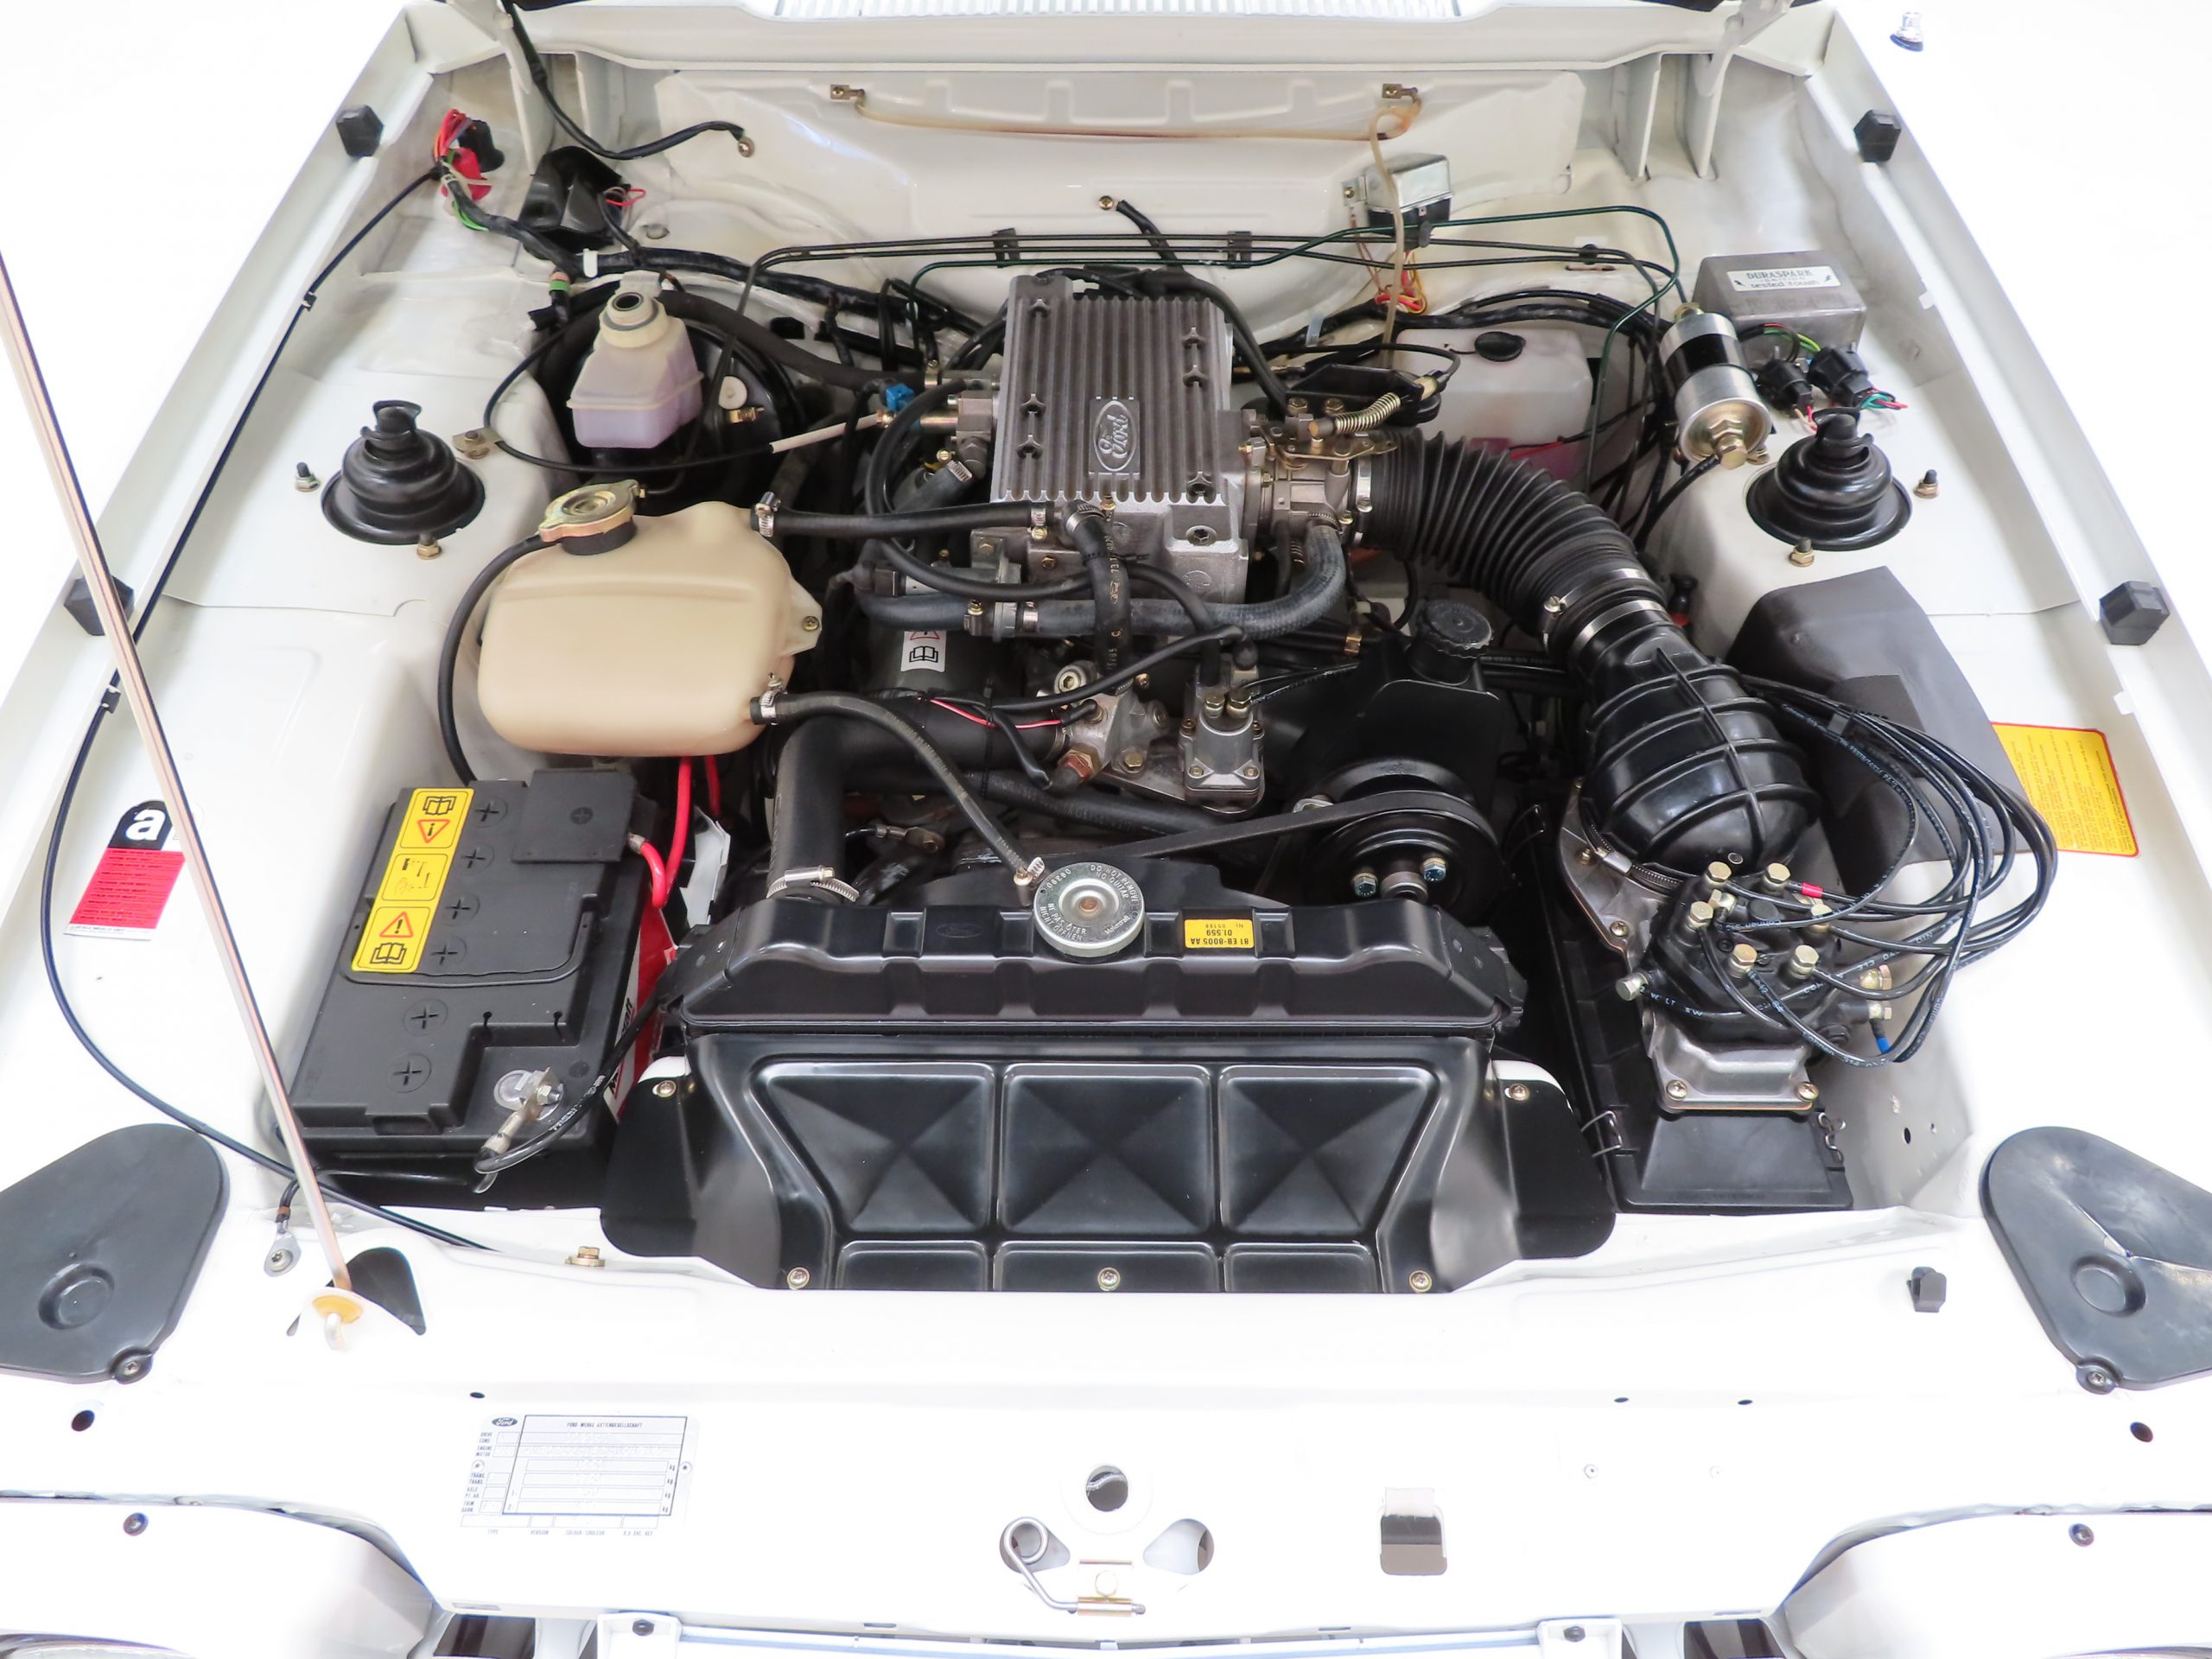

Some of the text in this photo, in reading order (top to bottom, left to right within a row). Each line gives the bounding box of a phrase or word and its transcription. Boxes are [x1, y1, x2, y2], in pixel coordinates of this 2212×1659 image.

[1746, 270, 1813, 279] DURASPARK
[1097, 413, 1129, 460] Ford
[125, 809, 166, 841] a
[1106, 868, 1122, 880] NOT
[1122, 878, 1139, 903] REMOVE
[1109, 877, 1129, 899] QUITAR
[1039, 906, 1054, 925] NICHT
[1047, 903, 1056, 915] NE
[1051, 912, 1065, 928] PAS
[1104, 914, 1131, 936] Motorcraft
